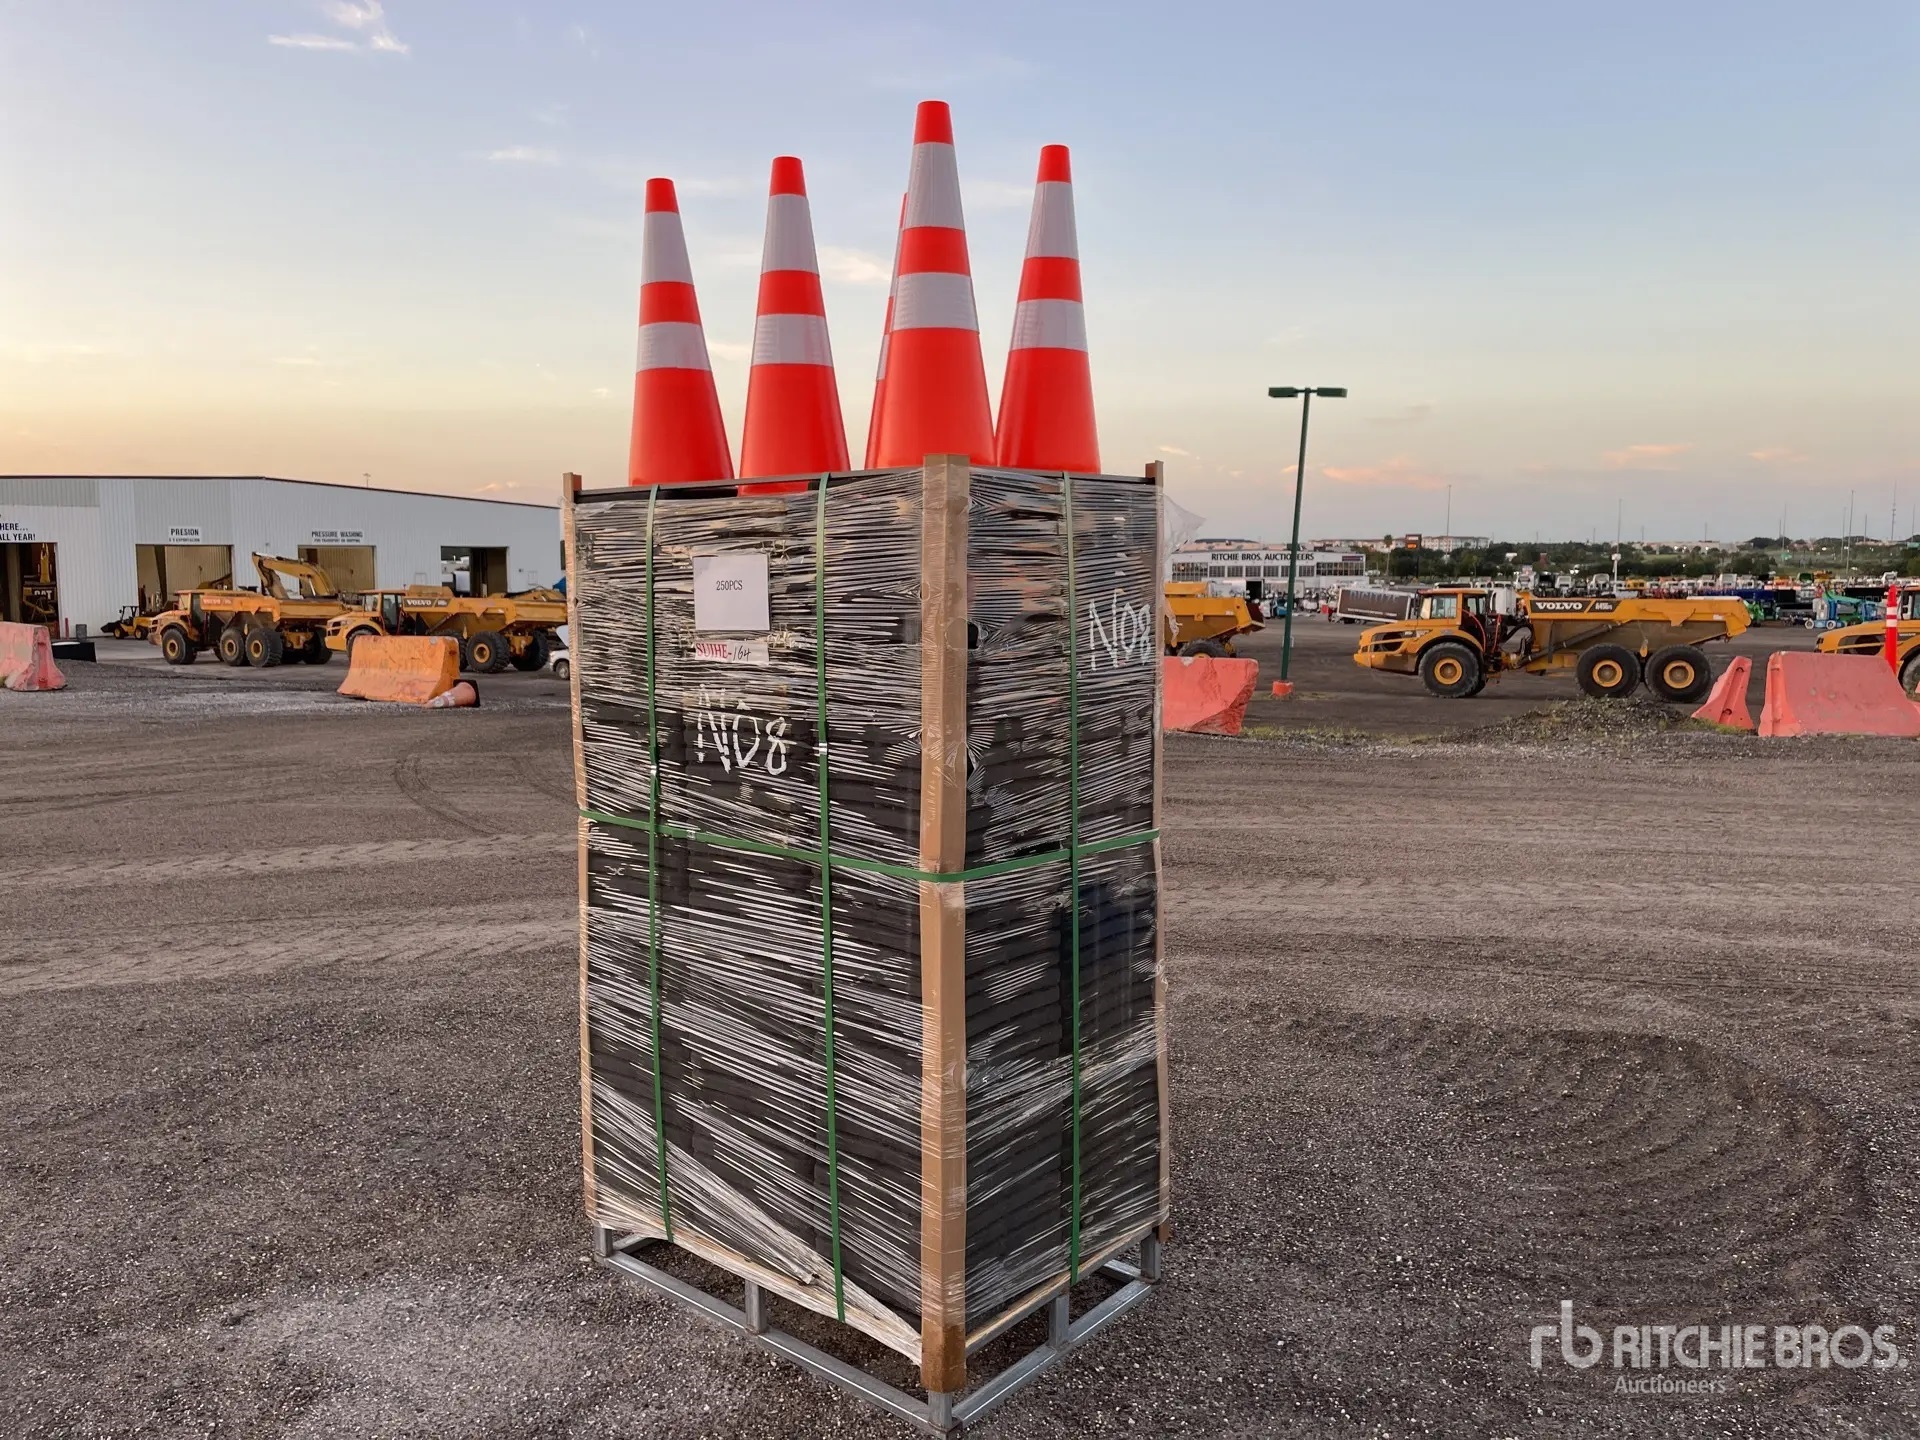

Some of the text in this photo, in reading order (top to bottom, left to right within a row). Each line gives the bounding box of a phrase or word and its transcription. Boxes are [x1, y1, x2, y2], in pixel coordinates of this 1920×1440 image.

[170, 528, 199, 536] PRESION
[13, 533, 36, 541] YEAR!
[1211, 553, 1314, 561] RITCHIE BROS. AUCTIOEERS
[716, 580, 743, 591] 250PCS
[1535, 602, 1583, 610] VOLVO
